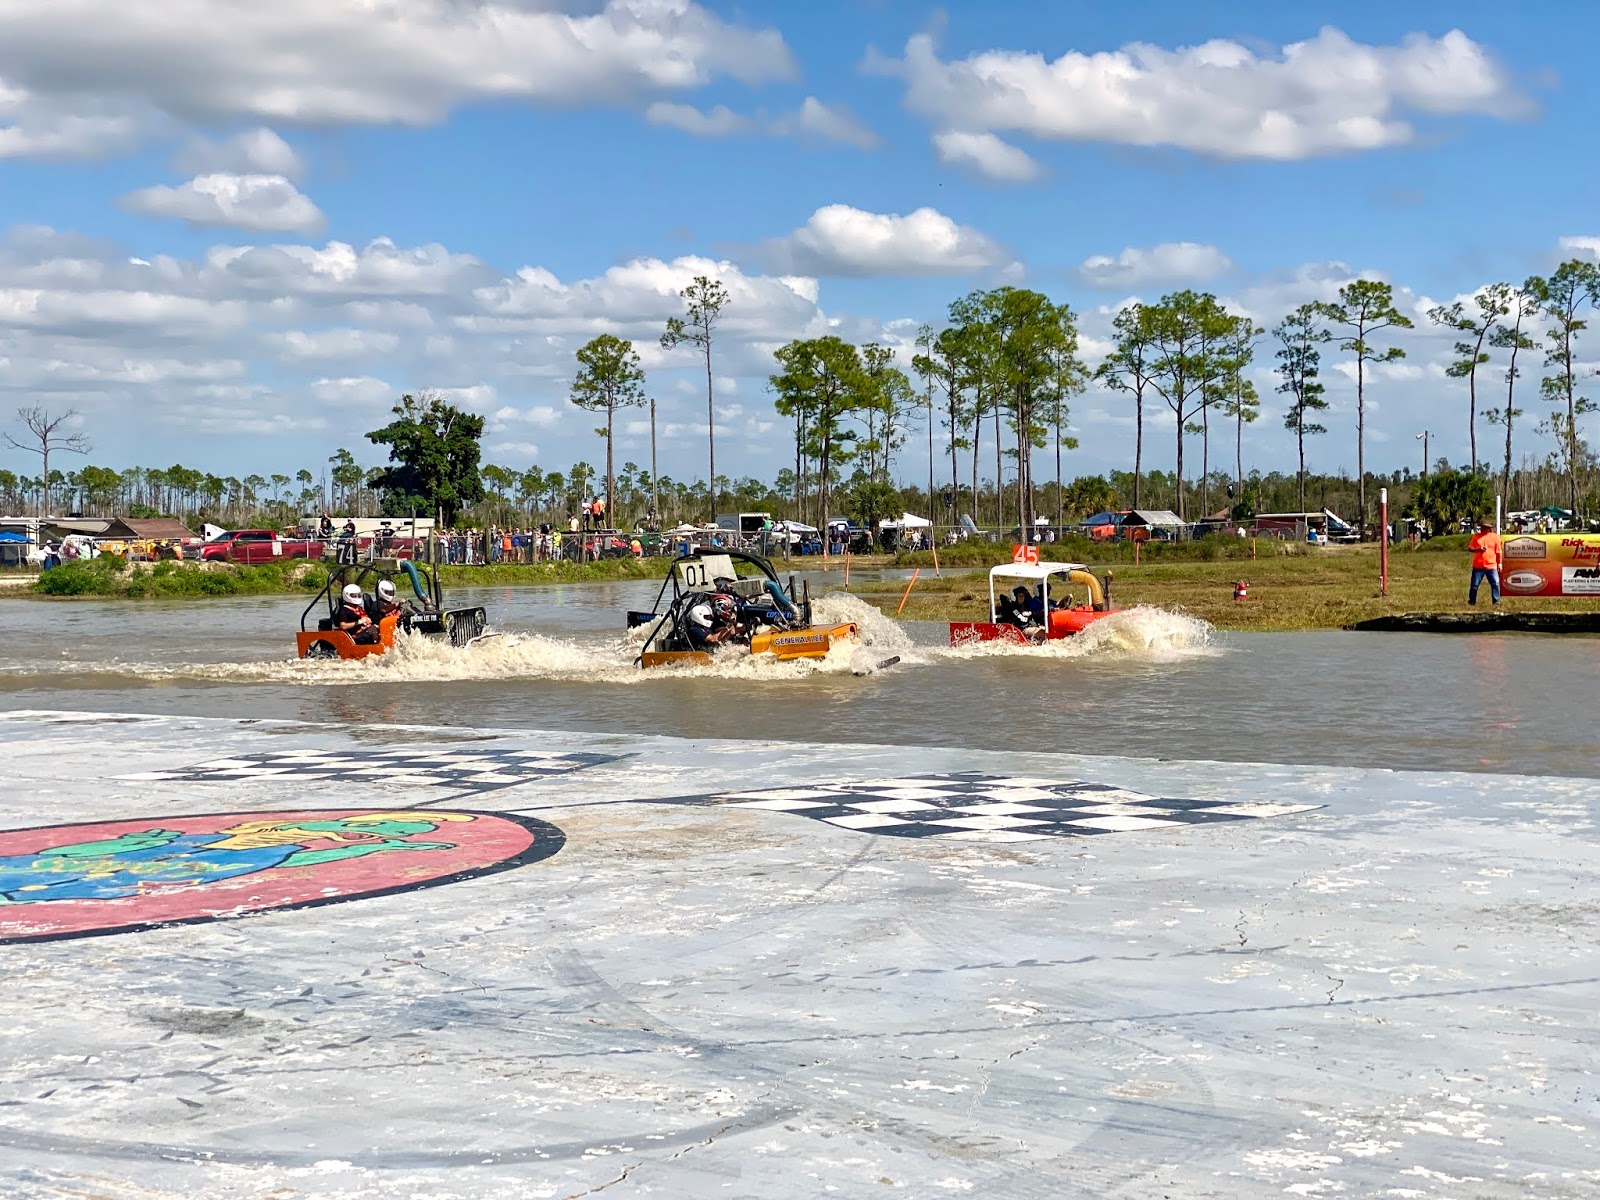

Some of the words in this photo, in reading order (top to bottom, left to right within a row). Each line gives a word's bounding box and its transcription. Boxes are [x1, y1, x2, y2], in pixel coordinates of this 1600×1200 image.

[1561, 537, 1584, 546] Rick
[337, 544, 355, 565] 74
[1014, 545, 1038, 564] 45
[686, 564, 708, 587] 01
[774, 635, 809, 646] GENERAL
[810, 634, 824, 643] LEE
